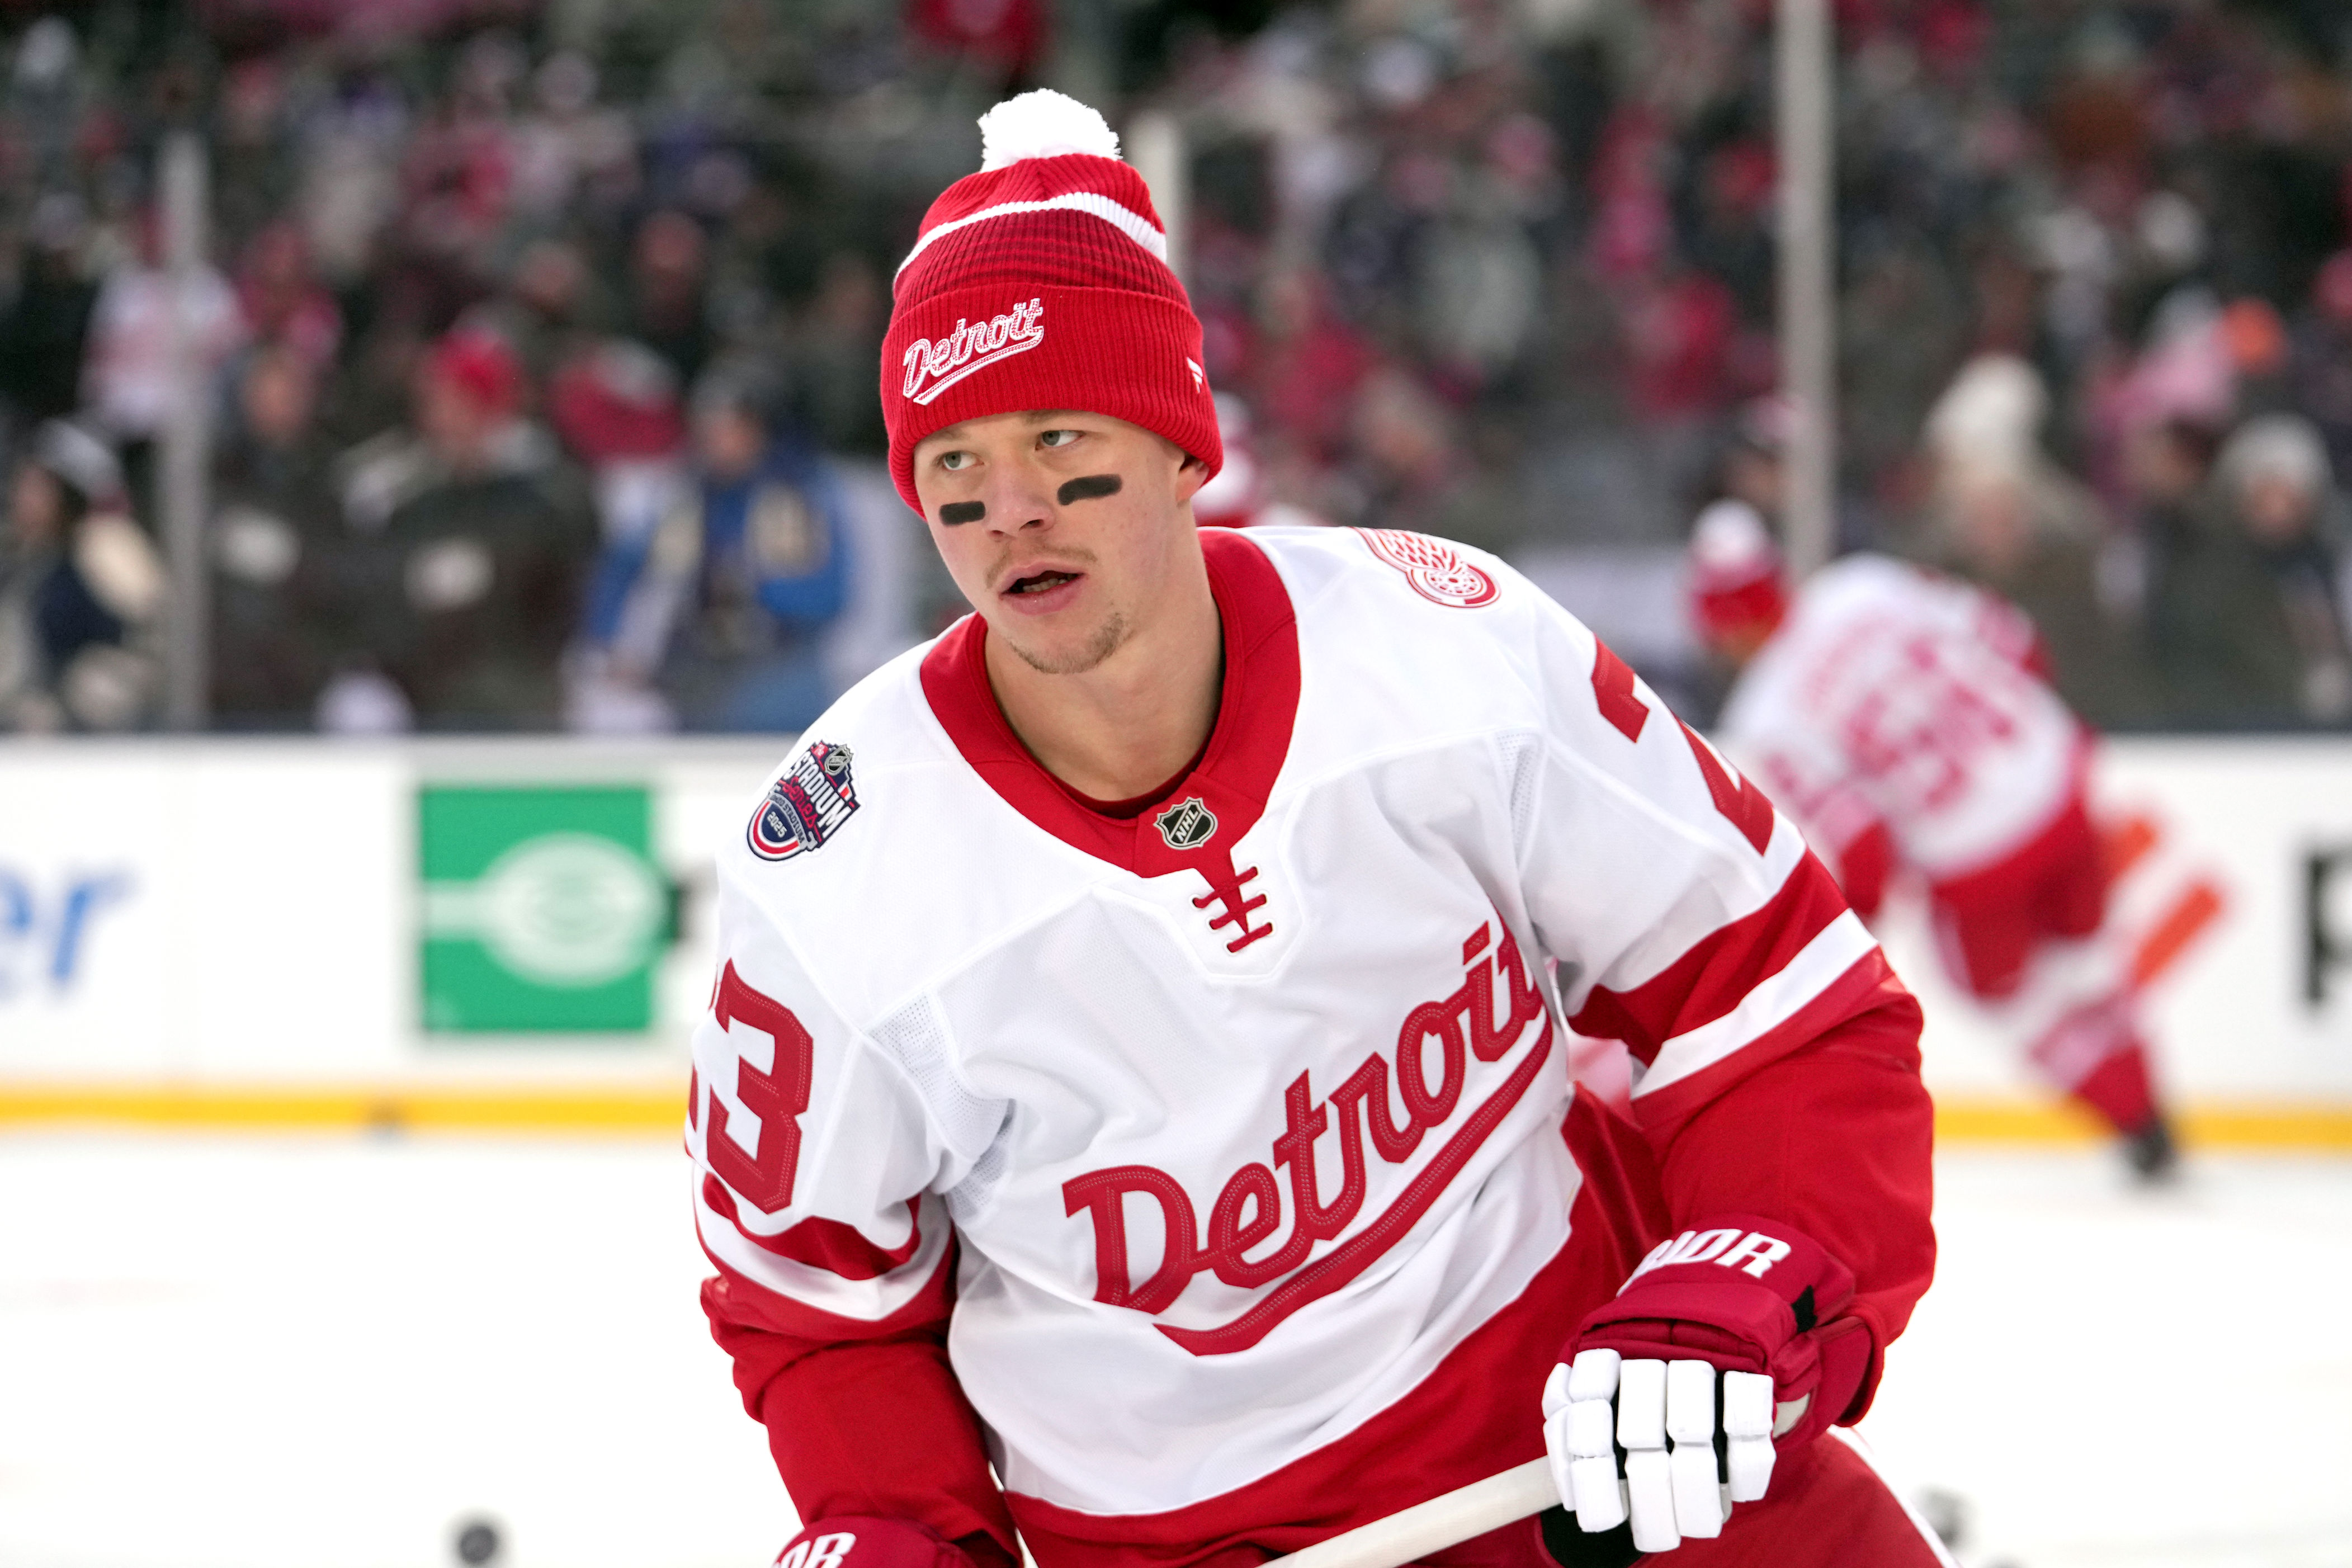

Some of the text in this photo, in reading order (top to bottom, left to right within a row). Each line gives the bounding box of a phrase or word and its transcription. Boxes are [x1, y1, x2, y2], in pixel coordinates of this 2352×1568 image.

[903, 297, 1044, 399] Detroit
[783, 750, 852, 838] STADIUM
[783, 776, 818, 828] Series
[767, 811, 787, 838] 2025
[783, 804, 805, 843] STADIUM
[1175, 809, 1198, 842] NHL
[1062, 893, 1546, 1315] Detroit
